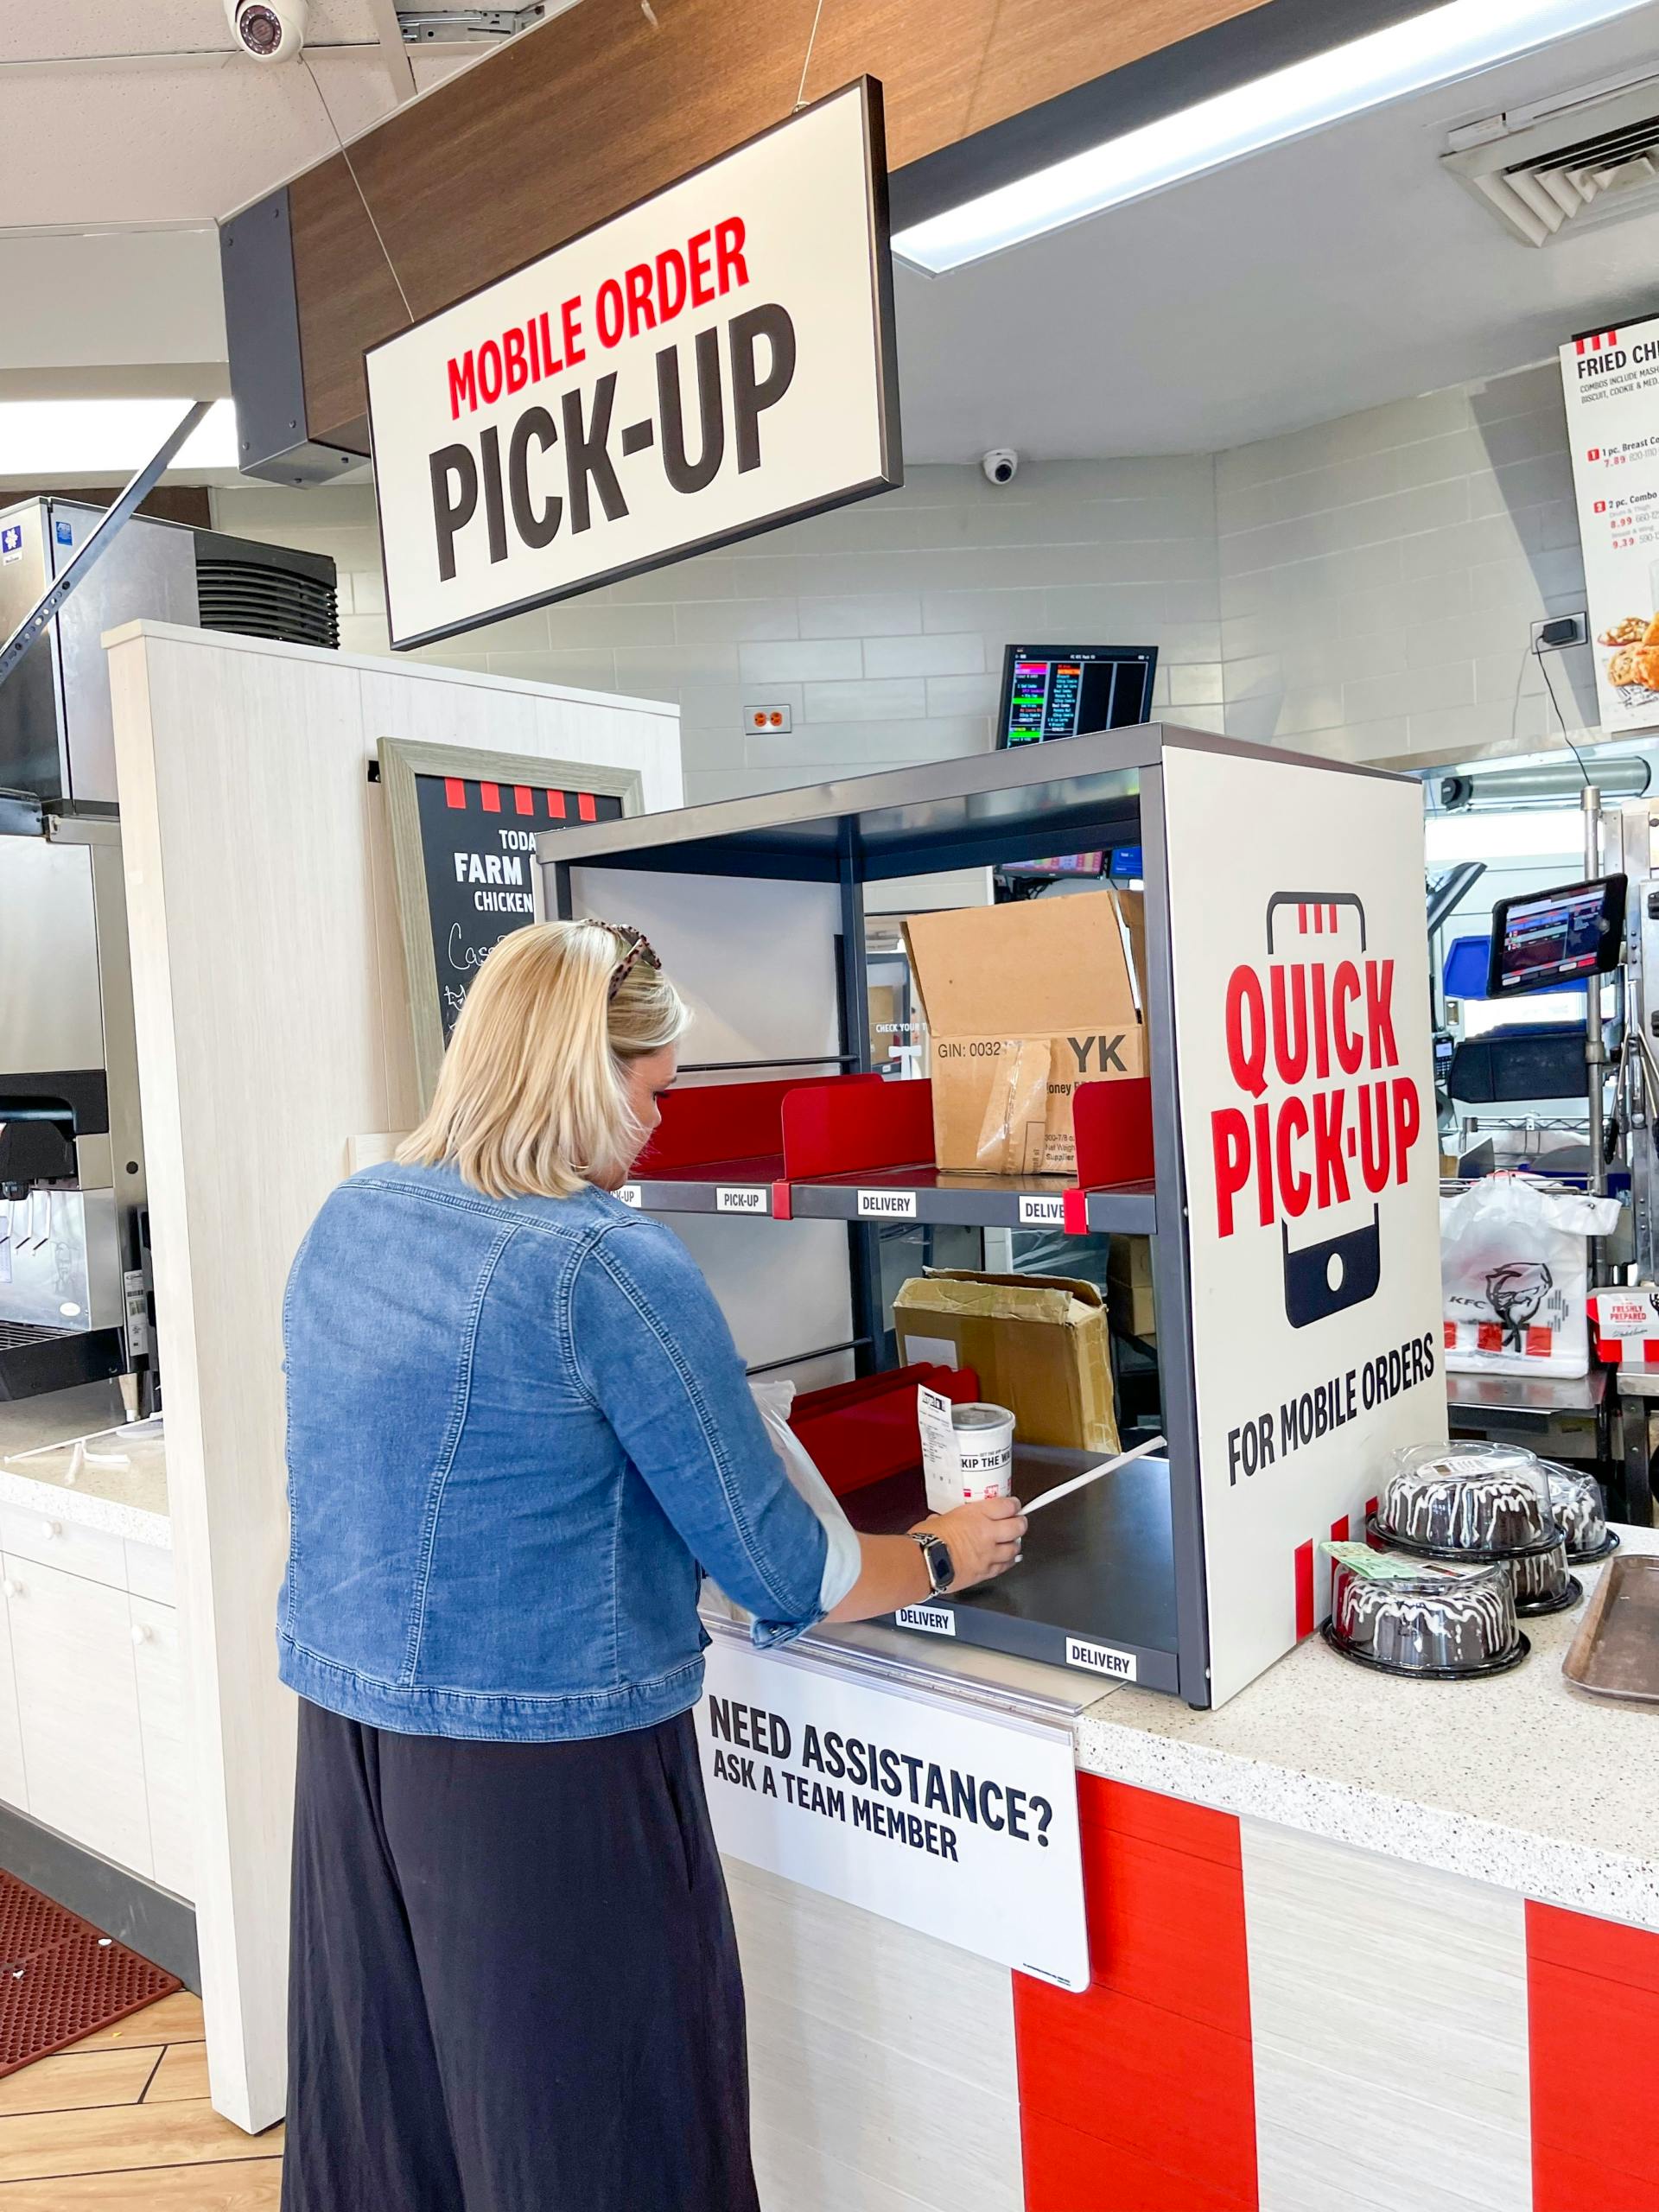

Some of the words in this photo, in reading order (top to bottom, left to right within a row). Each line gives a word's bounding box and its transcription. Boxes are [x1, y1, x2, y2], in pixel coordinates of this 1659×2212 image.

[448, 296, 586, 421] MOBILE
[595, 216, 749, 349] ORDER
[1577, 351, 1626, 378] FRIED
[1580, 380, 1608, 393] COMBOS
[1610, 372, 1637, 385] INCLUDE
[1610, 384, 1634, 397] COOKIE
[429, 303, 797, 582] PICK-UP
[1622, 439, 1648, 451] Breast
[1604, 455, 1626, 467] 7.89
[1630, 492, 1657, 504] Combo
[454, 853, 523, 886] FARM
[474, 891, 534, 912] CHICKEN
[876, 1023, 898, 1033] CHECK
[899, 1022, 919, 1032] YOUR
[1225, 958, 1398, 1098] QUICK
[938, 1043, 966, 1058] GIN:
[969, 1041, 1001, 1057] 0032
[1067, 1034, 1128, 1073] YK
[1211, 1077, 1420, 1237] PICK-UP
[724, 1193, 759, 1206] PICK-UP
[863, 1197, 910, 1211] DELIVERY
[1448, 1296, 1488, 1309] KFC
[1228, 1414, 1275, 1486] FOR
[1280, 1369, 1357, 1458] MOBILE
[1362, 1332, 1434, 1410] ORDERS
[961, 1459, 979, 1468] KIP
[982, 1455, 999, 1467] THE
[900, 1609, 949, 1630] DELIVERY
[1072, 1645, 1130, 1674] DELIVERY
[709, 1694, 791, 1759] NEED
[802, 1724, 1052, 1847] ASSISTANCE?
[714, 1750, 756, 1790] ASK
[762, 1766, 778, 1798] A
[781, 1771, 846, 1821] TEAM
[852, 1796, 958, 1863] MEMBER
